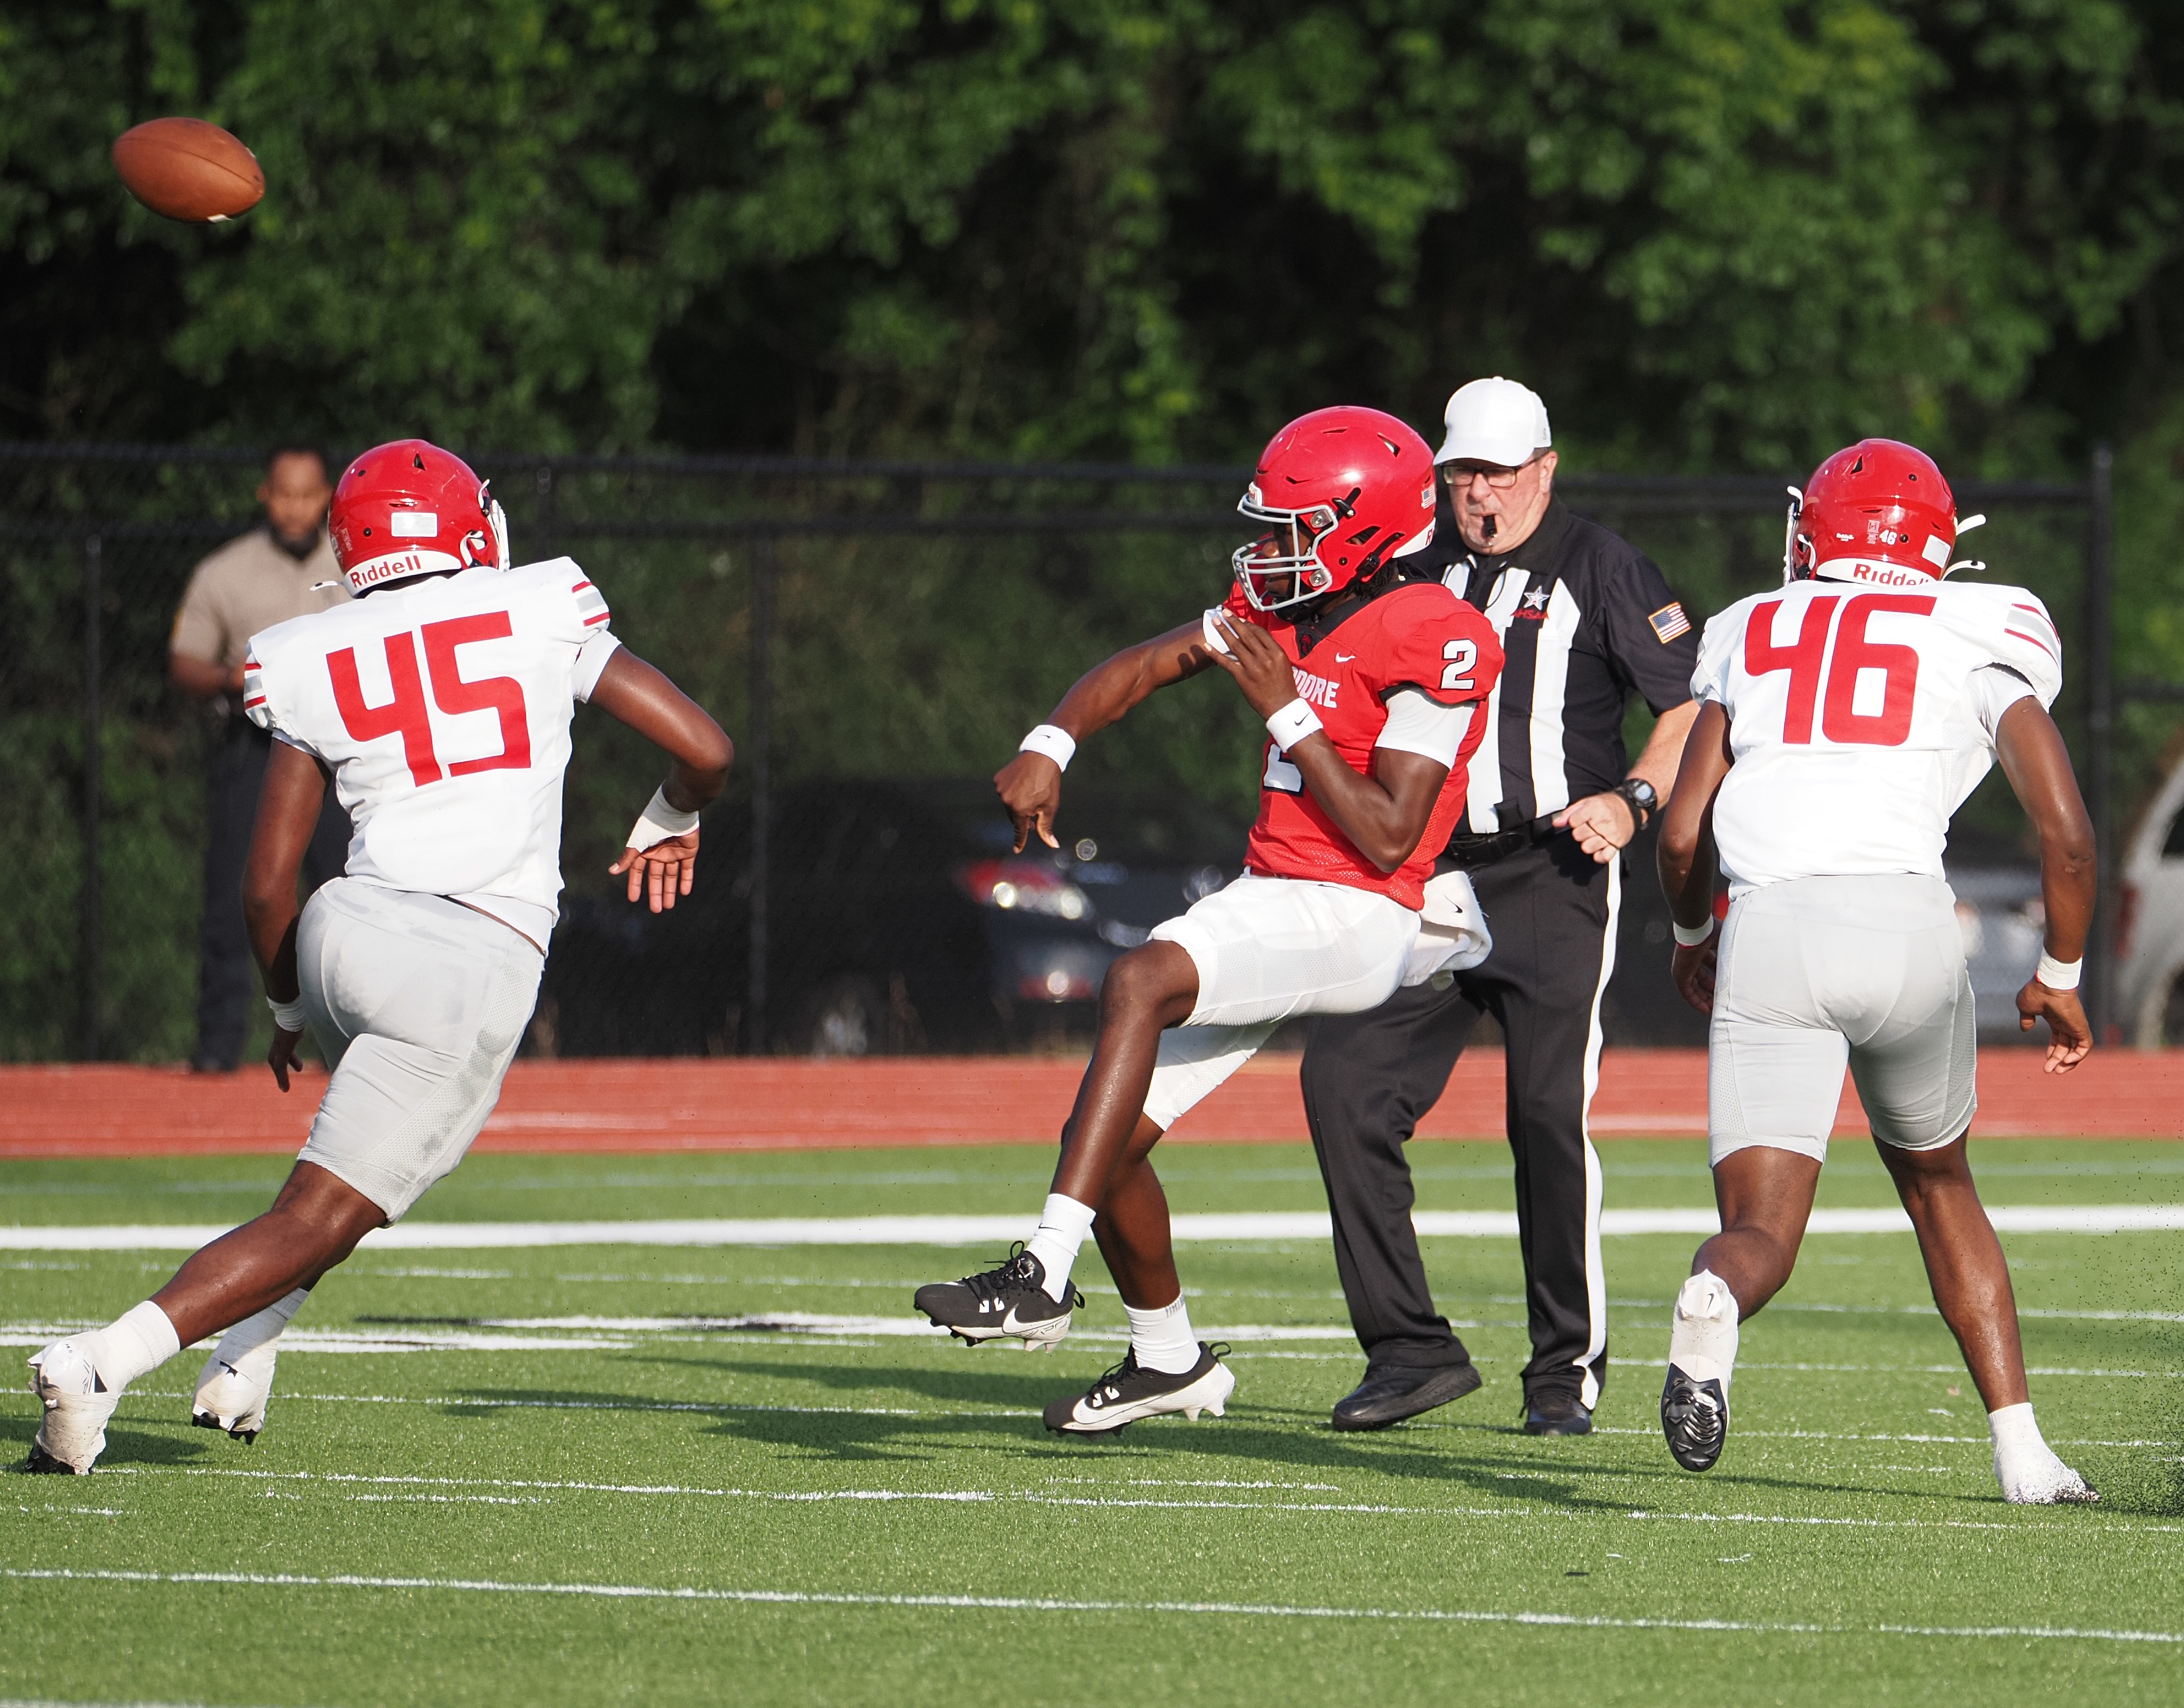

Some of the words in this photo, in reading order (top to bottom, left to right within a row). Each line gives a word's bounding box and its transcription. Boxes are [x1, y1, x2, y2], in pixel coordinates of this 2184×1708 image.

[1879, 530, 1897, 545] 46
[350, 555, 422, 588] Riddell
[1853, 563, 1929, 586] Ridde
[1439, 637, 1478, 691] 2
[1744, 593, 1938, 747] 46
[326, 610, 531, 788] 45
